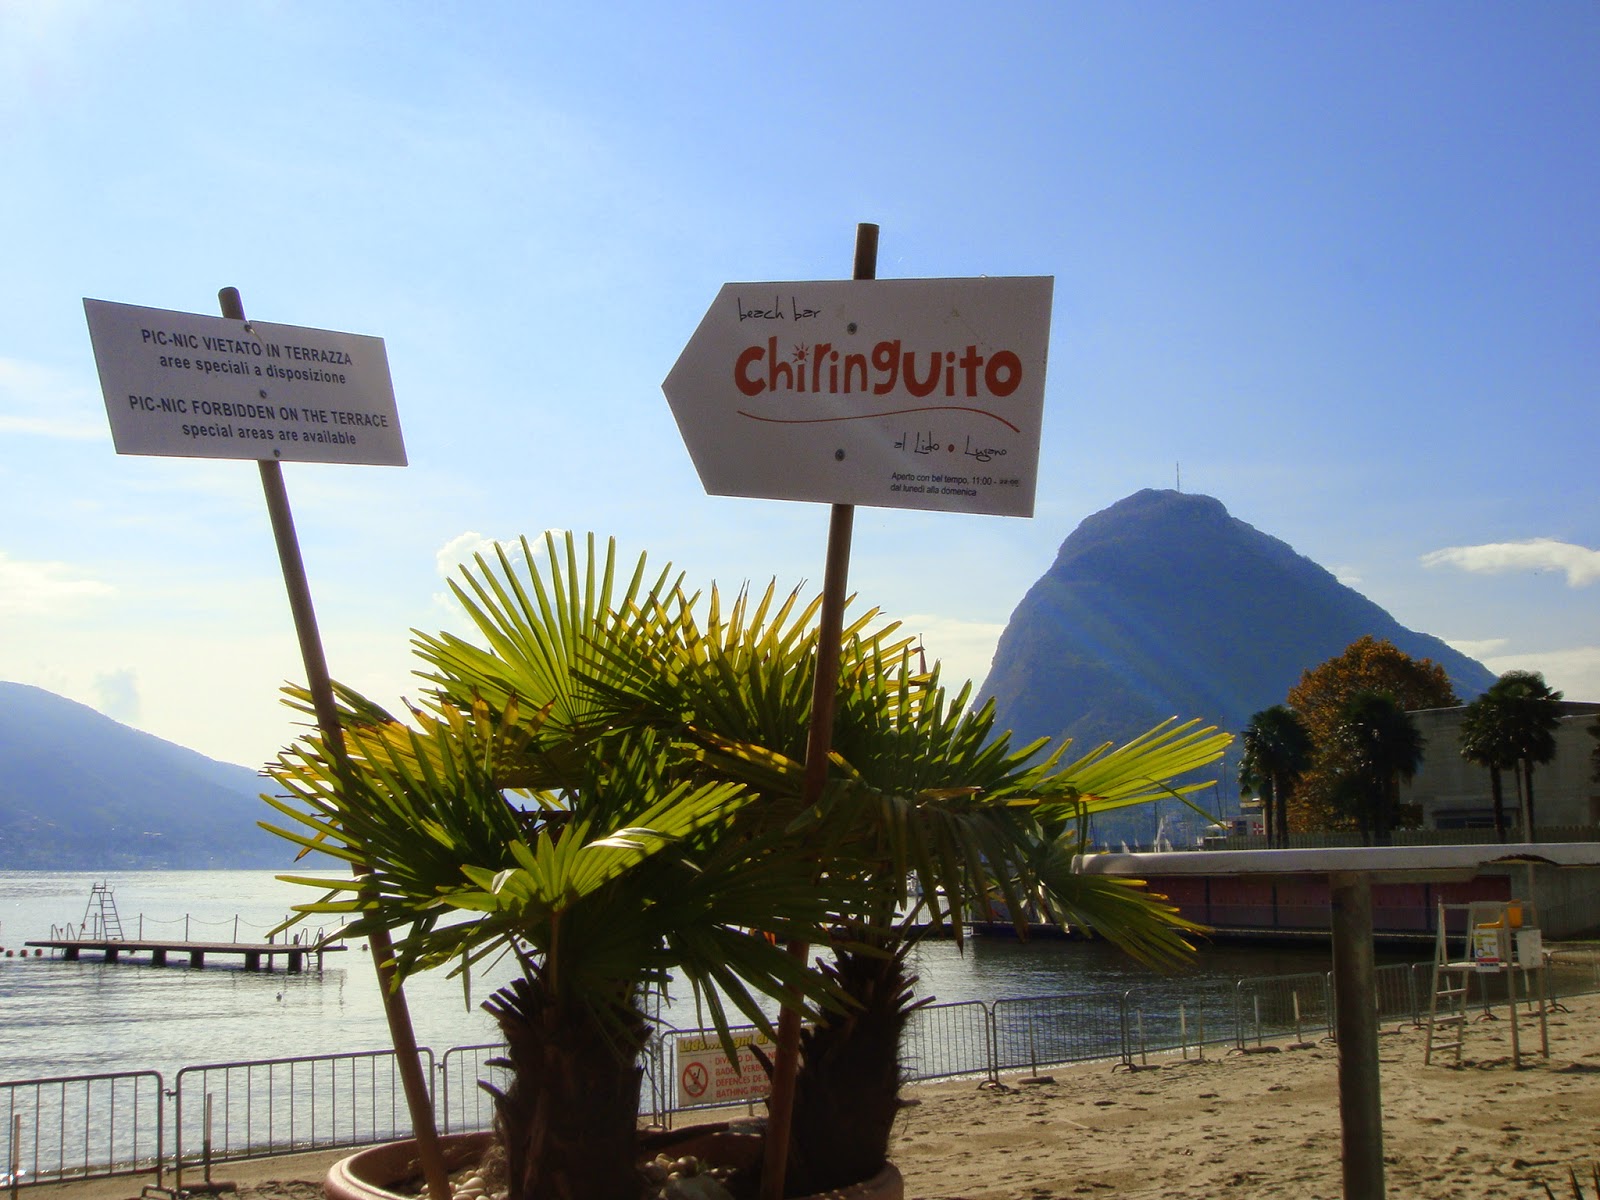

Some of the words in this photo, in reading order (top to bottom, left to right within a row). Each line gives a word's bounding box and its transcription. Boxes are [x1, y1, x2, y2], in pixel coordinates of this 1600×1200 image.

[737, 296, 784, 321] beach
[791, 296, 821, 321] bar
[141, 328, 199, 350] PIC-NIC
[203, 335, 262, 356] VIETATO
[265, 343, 280, 358] IN
[285, 345, 353, 366] TERRAZZA
[159, 354, 190, 369] aree
[196, 358, 250, 376] speciali
[254, 366, 262, 376] a
[266, 364, 346, 384] disposizione
[734, 335, 1023, 397] chiringuito
[128, 395, 187, 413] PIC-NIC
[192, 401, 276, 420] FORBIDDEN
[279, 407, 298, 421] ON
[302, 408, 327, 424] THE
[331, 411, 389, 428] TERRACE
[182, 422, 233, 438] special
[238, 428, 274, 440] areas
[278, 430, 298, 442] are
[303, 430, 356, 445] available
[893, 431, 906, 450] al
[914, 430, 940, 454] Lido
[964, 435, 1007, 462] Lugano
[890, 483, 901, 491] dal
[926, 486, 939, 494] alla
[941, 487, 977, 496] domenica
[891, 472, 914, 481] Aperto
[931, 474, 943, 482] bel
[972, 476, 992, 486] 11:00
[753, 1074, 762, 1083] DE
[716, 1087, 749, 1098] BATHING
